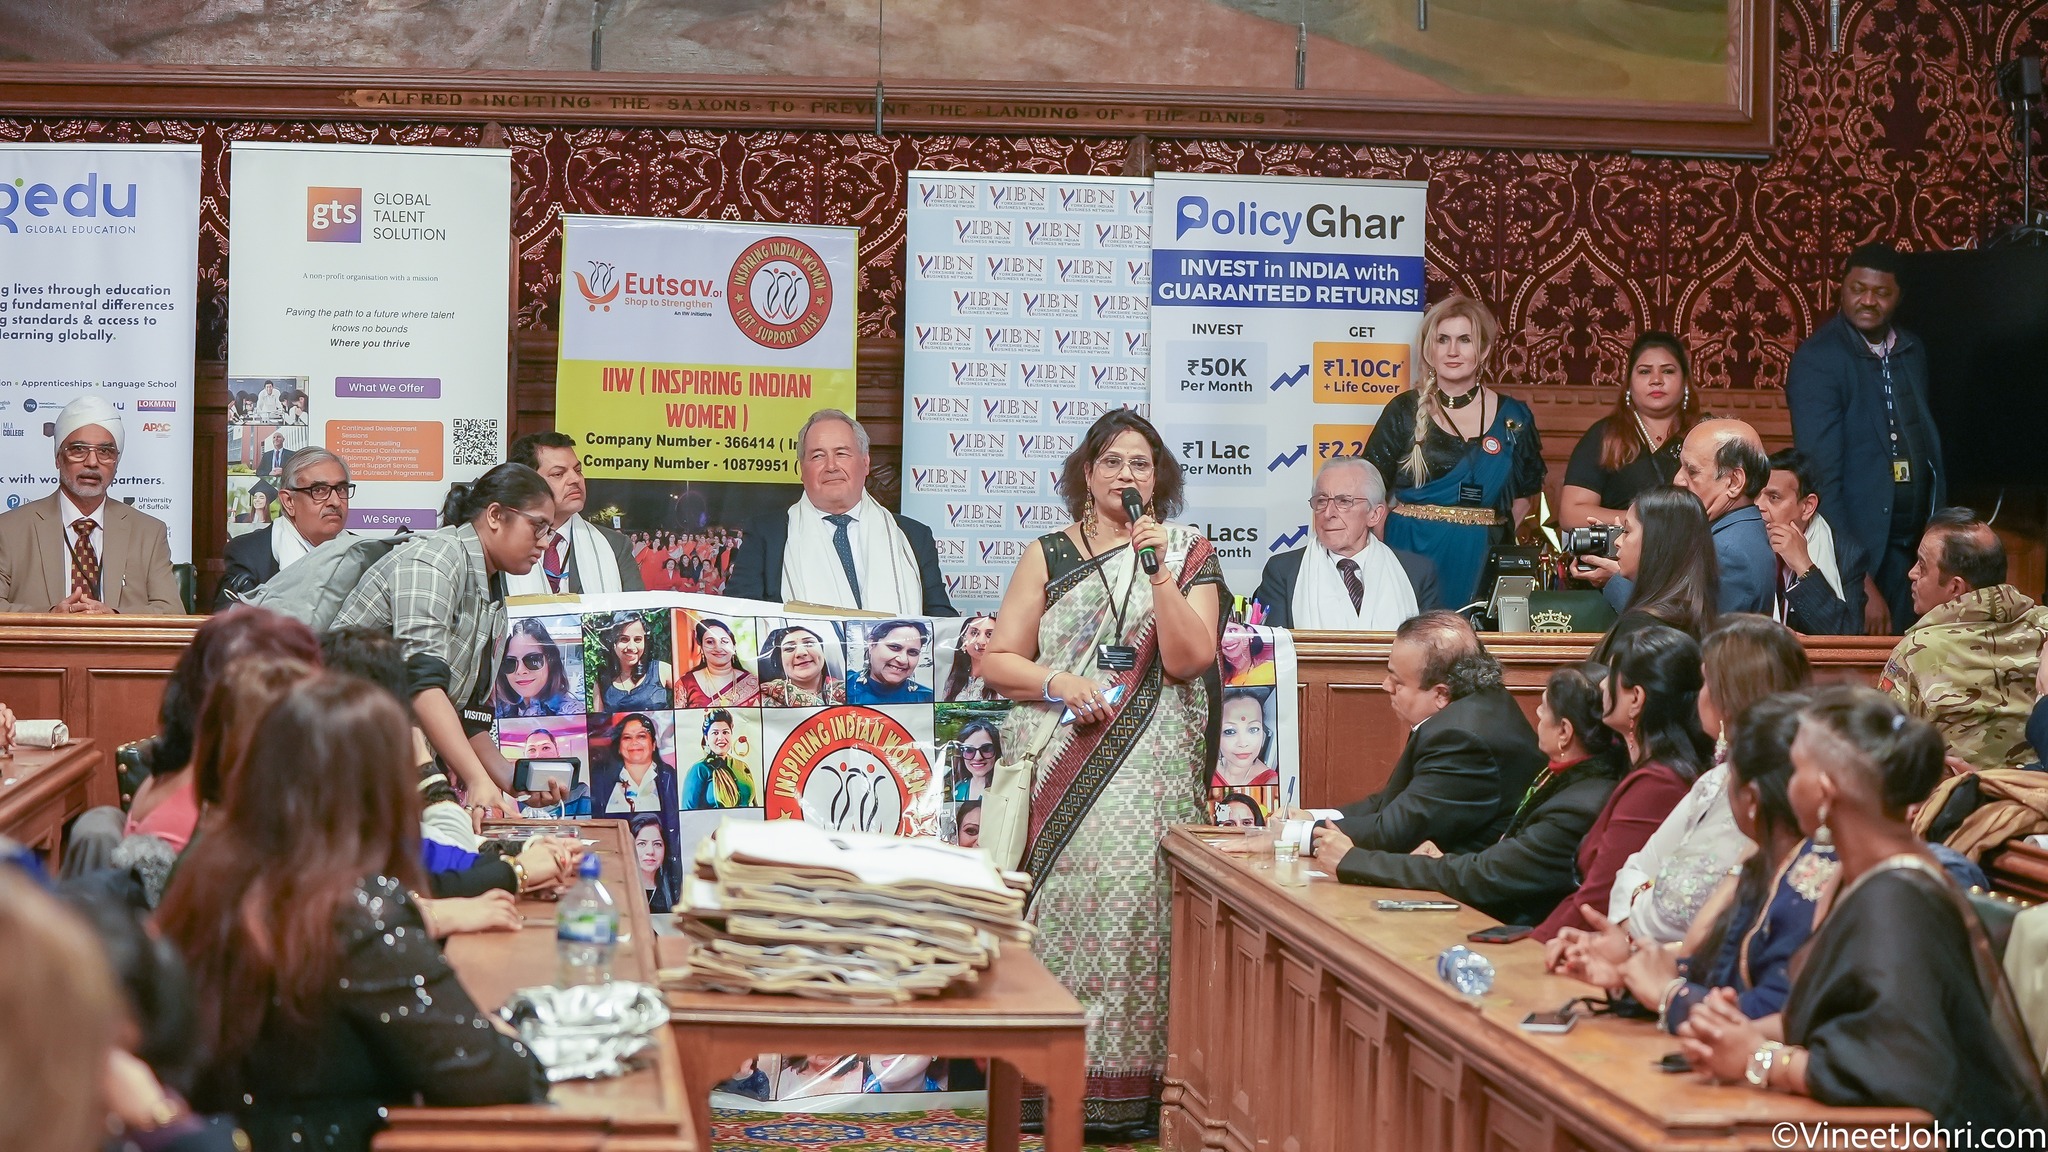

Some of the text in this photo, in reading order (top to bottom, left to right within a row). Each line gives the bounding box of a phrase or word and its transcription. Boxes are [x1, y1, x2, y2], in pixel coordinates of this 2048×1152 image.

[378, 92, 462, 106] ALFRED
[483, 94, 592, 109] INCITING
[611, 97, 650, 110] THE
[668, 98, 751, 112] SAXONS
[768, 101, 794, 113] TO
[928, 105, 968, 117] THE
[986, 106, 1079, 120] LANDING
[1097, 108, 1122, 120] OF
[1144, 110, 1184, 122] THE
[1200, 110, 1266, 124] DANES
[374, 192, 431, 206] GLOBAL
[312, 200, 356, 230] gts
[374, 210, 426, 223] TALENT
[1176, 196, 1404, 245] PolicyGhar
[26, 225, 136, 234] GLOBAL EDUCATION
[374, 228, 446, 241] SOLUTION
[734, 242, 827, 289] INSPIRING INDIAN WOMEN
[1180, 259, 1399, 282] INVEST in INDIA with
[309, 272, 345, 281] non-profit
[346, 274, 388, 283] organisation
[14, 283, 43, 294] lives
[48, 284, 100, 297] through
[106, 285, 171, 295] education
[1158, 282, 1418, 306] GUARANTEED RETURNS!
[12, 298, 97, 310] fundamental
[102, 299, 174, 311] differences
[625, 298, 648, 308] Shop
[662, 299, 712, 310] Strengthen
[12, 314, 78, 325] standards
[83, 315, 93, 325] &
[98, 317, 139, 326] access
[144, 316, 157, 326] to
[286, 308, 316, 318] Paving
[318, 309, 332, 317] the
[334, 309, 353, 318] path
[374, 310, 399, 318] future
[401, 310, 428, 319] where
[430, 311, 455, 319] talent
[332, 324, 359, 333] knows
[375, 324, 408, 333] bounds
[1192, 324, 1243, 336] INVEST
[1349, 326, 1375, 338] GET
[58, 329, 116, 343] globally.
[330, 338, 410, 349] Where you thrive
[1187, 358, 1247, 377] ₹50K
[22, 380, 93, 389] Apprenticeships
[102, 380, 146, 389] Language
[349, 382, 425, 393] What We Offer
[602, 367, 811, 398] IIW INSPIRING INDIAN
[1181, 381, 1253, 392] Per Month
[1334, 381, 1400, 393] Life Cover
[666, 403, 736, 430] WOMEN
[143, 423, 171, 431] APAC
[586, 432, 652, 452] Company
[656, 435, 711, 448] Number
[724, 436, 774, 450] 366414
[1182, 441, 1250, 460] ₹1 Lac
[584, 454, 788, 474] Company Number 10879951
[1181, 464, 1252, 475] Per Month
[9, 474, 35, 484] with
[363, 515, 411, 523] We Serve
[1207, 524, 1258, 542] Lacs
[1215, 546, 1251, 558] onth
[464, 709, 492, 722] VISITOR
[774, 714, 927, 798] INSPIRING INDIAN WOMEN
